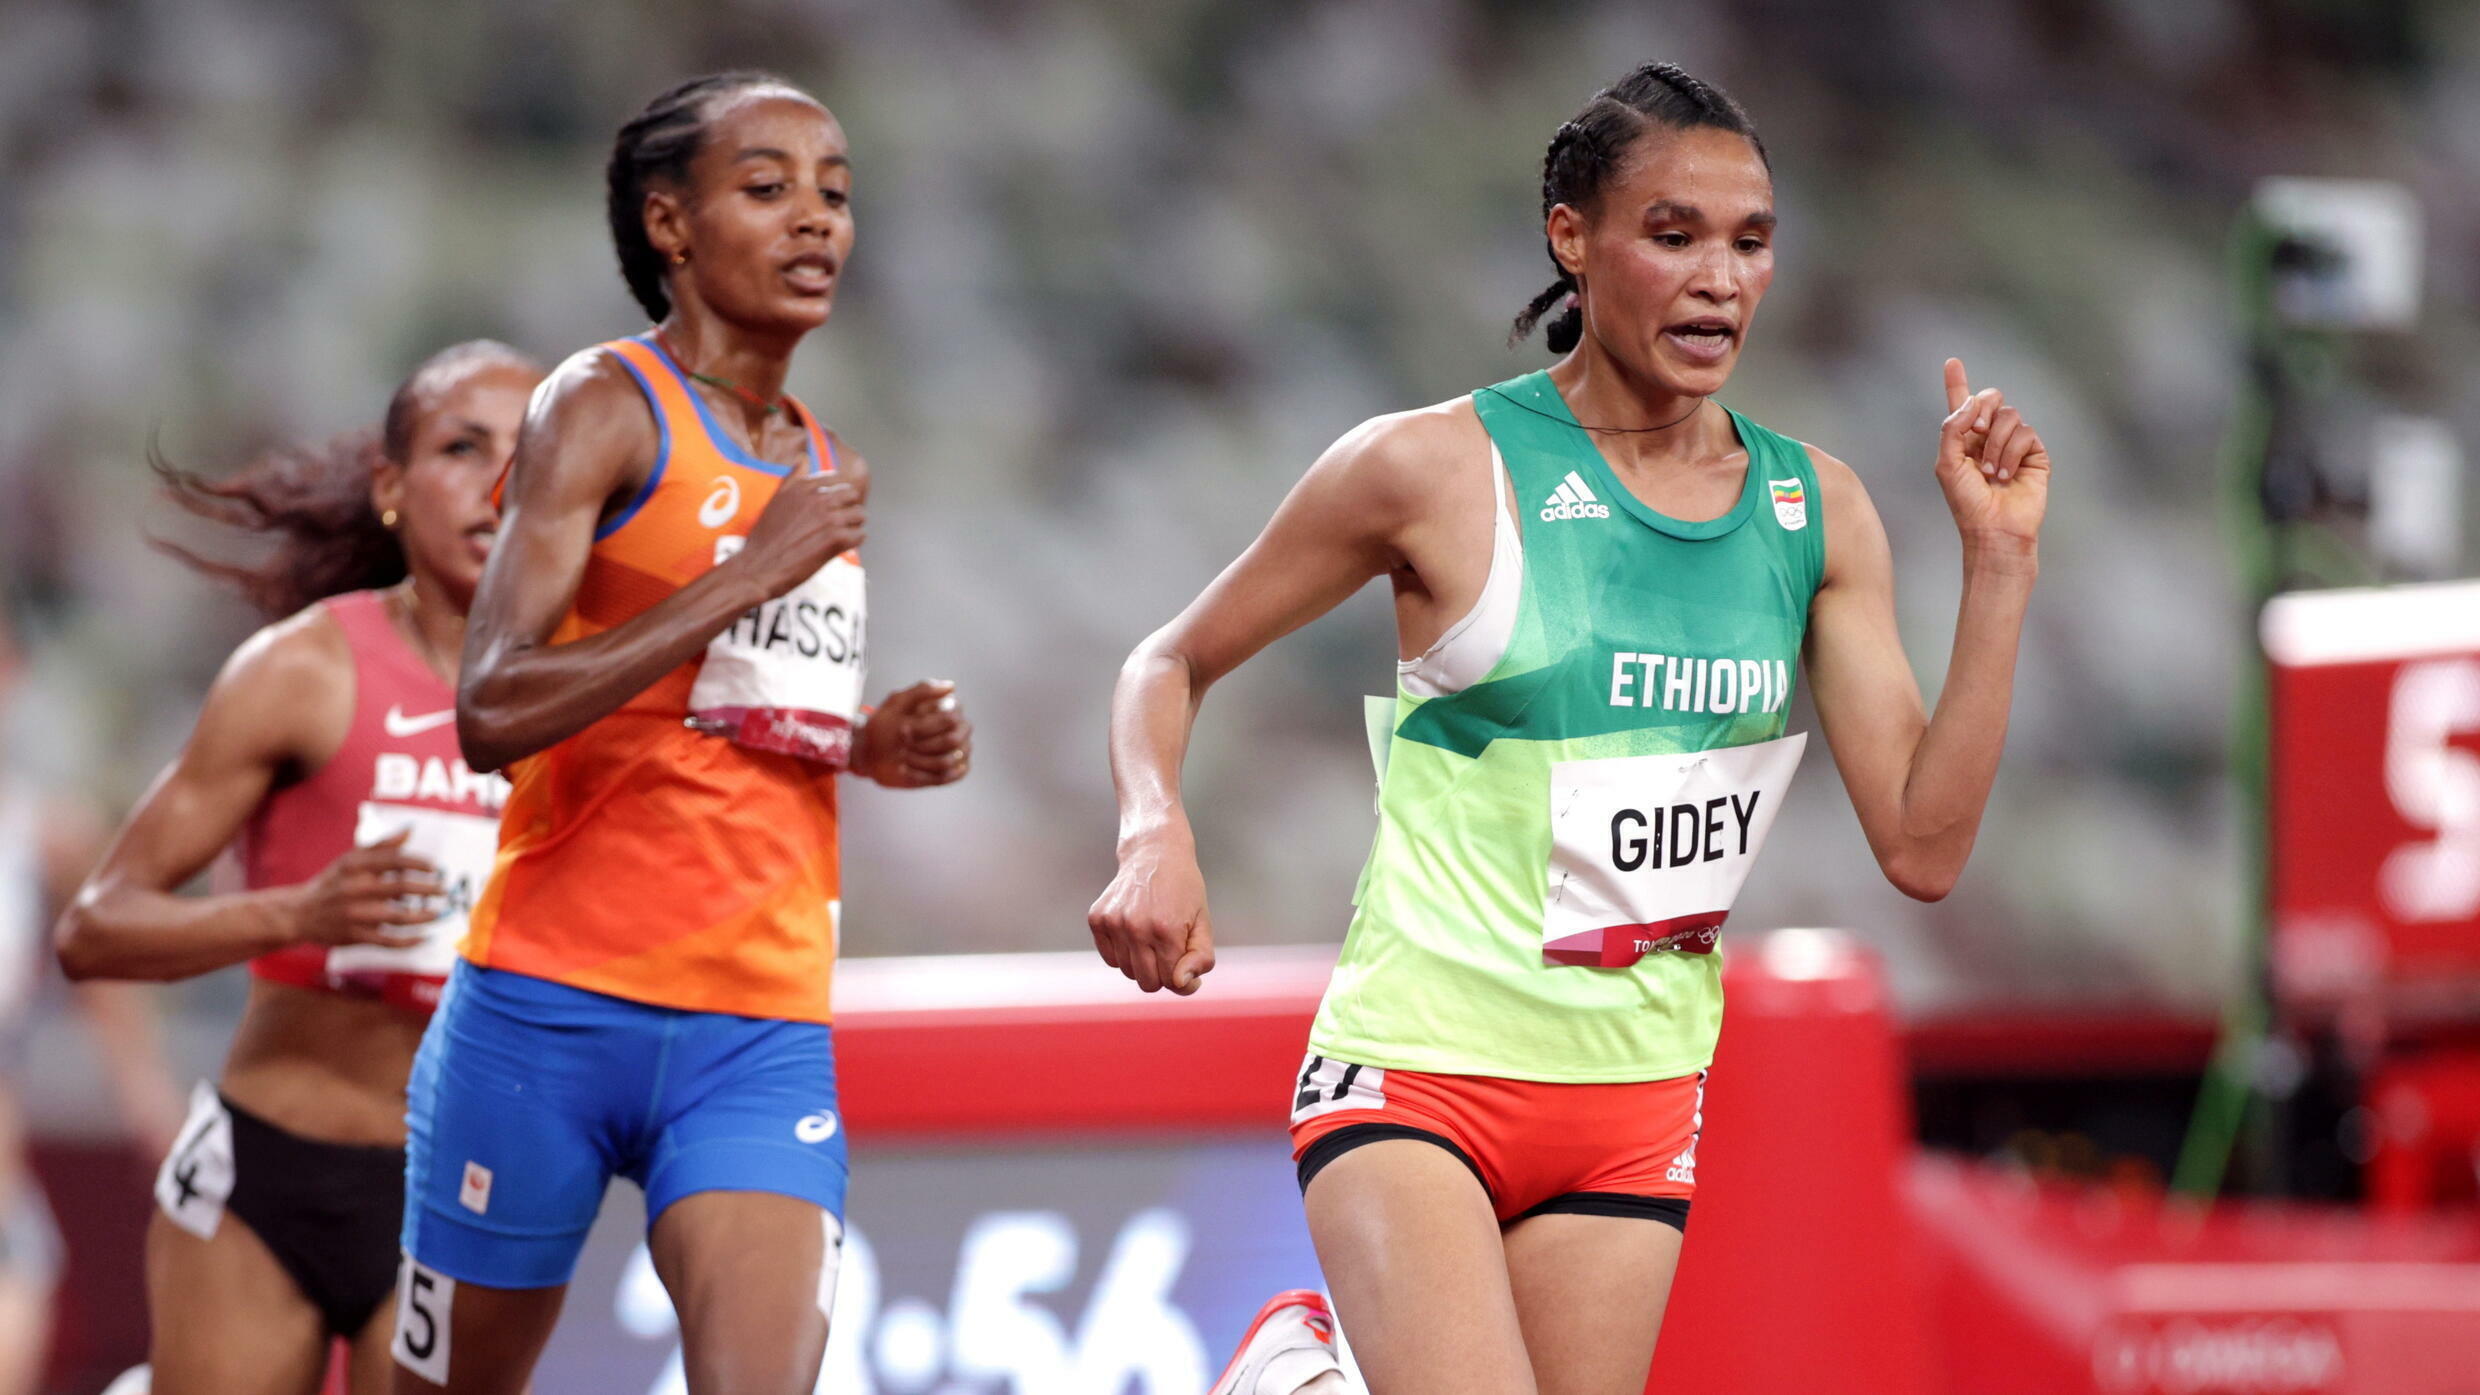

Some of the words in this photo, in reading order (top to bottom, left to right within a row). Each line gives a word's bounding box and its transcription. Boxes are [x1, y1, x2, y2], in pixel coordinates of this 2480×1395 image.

[1540, 501, 1610, 522] adidas
[1609, 652, 1788, 714] ETHIOPIA
[1611, 790, 1760, 872] GIDEY
[404, 1269, 436, 1360] 5
